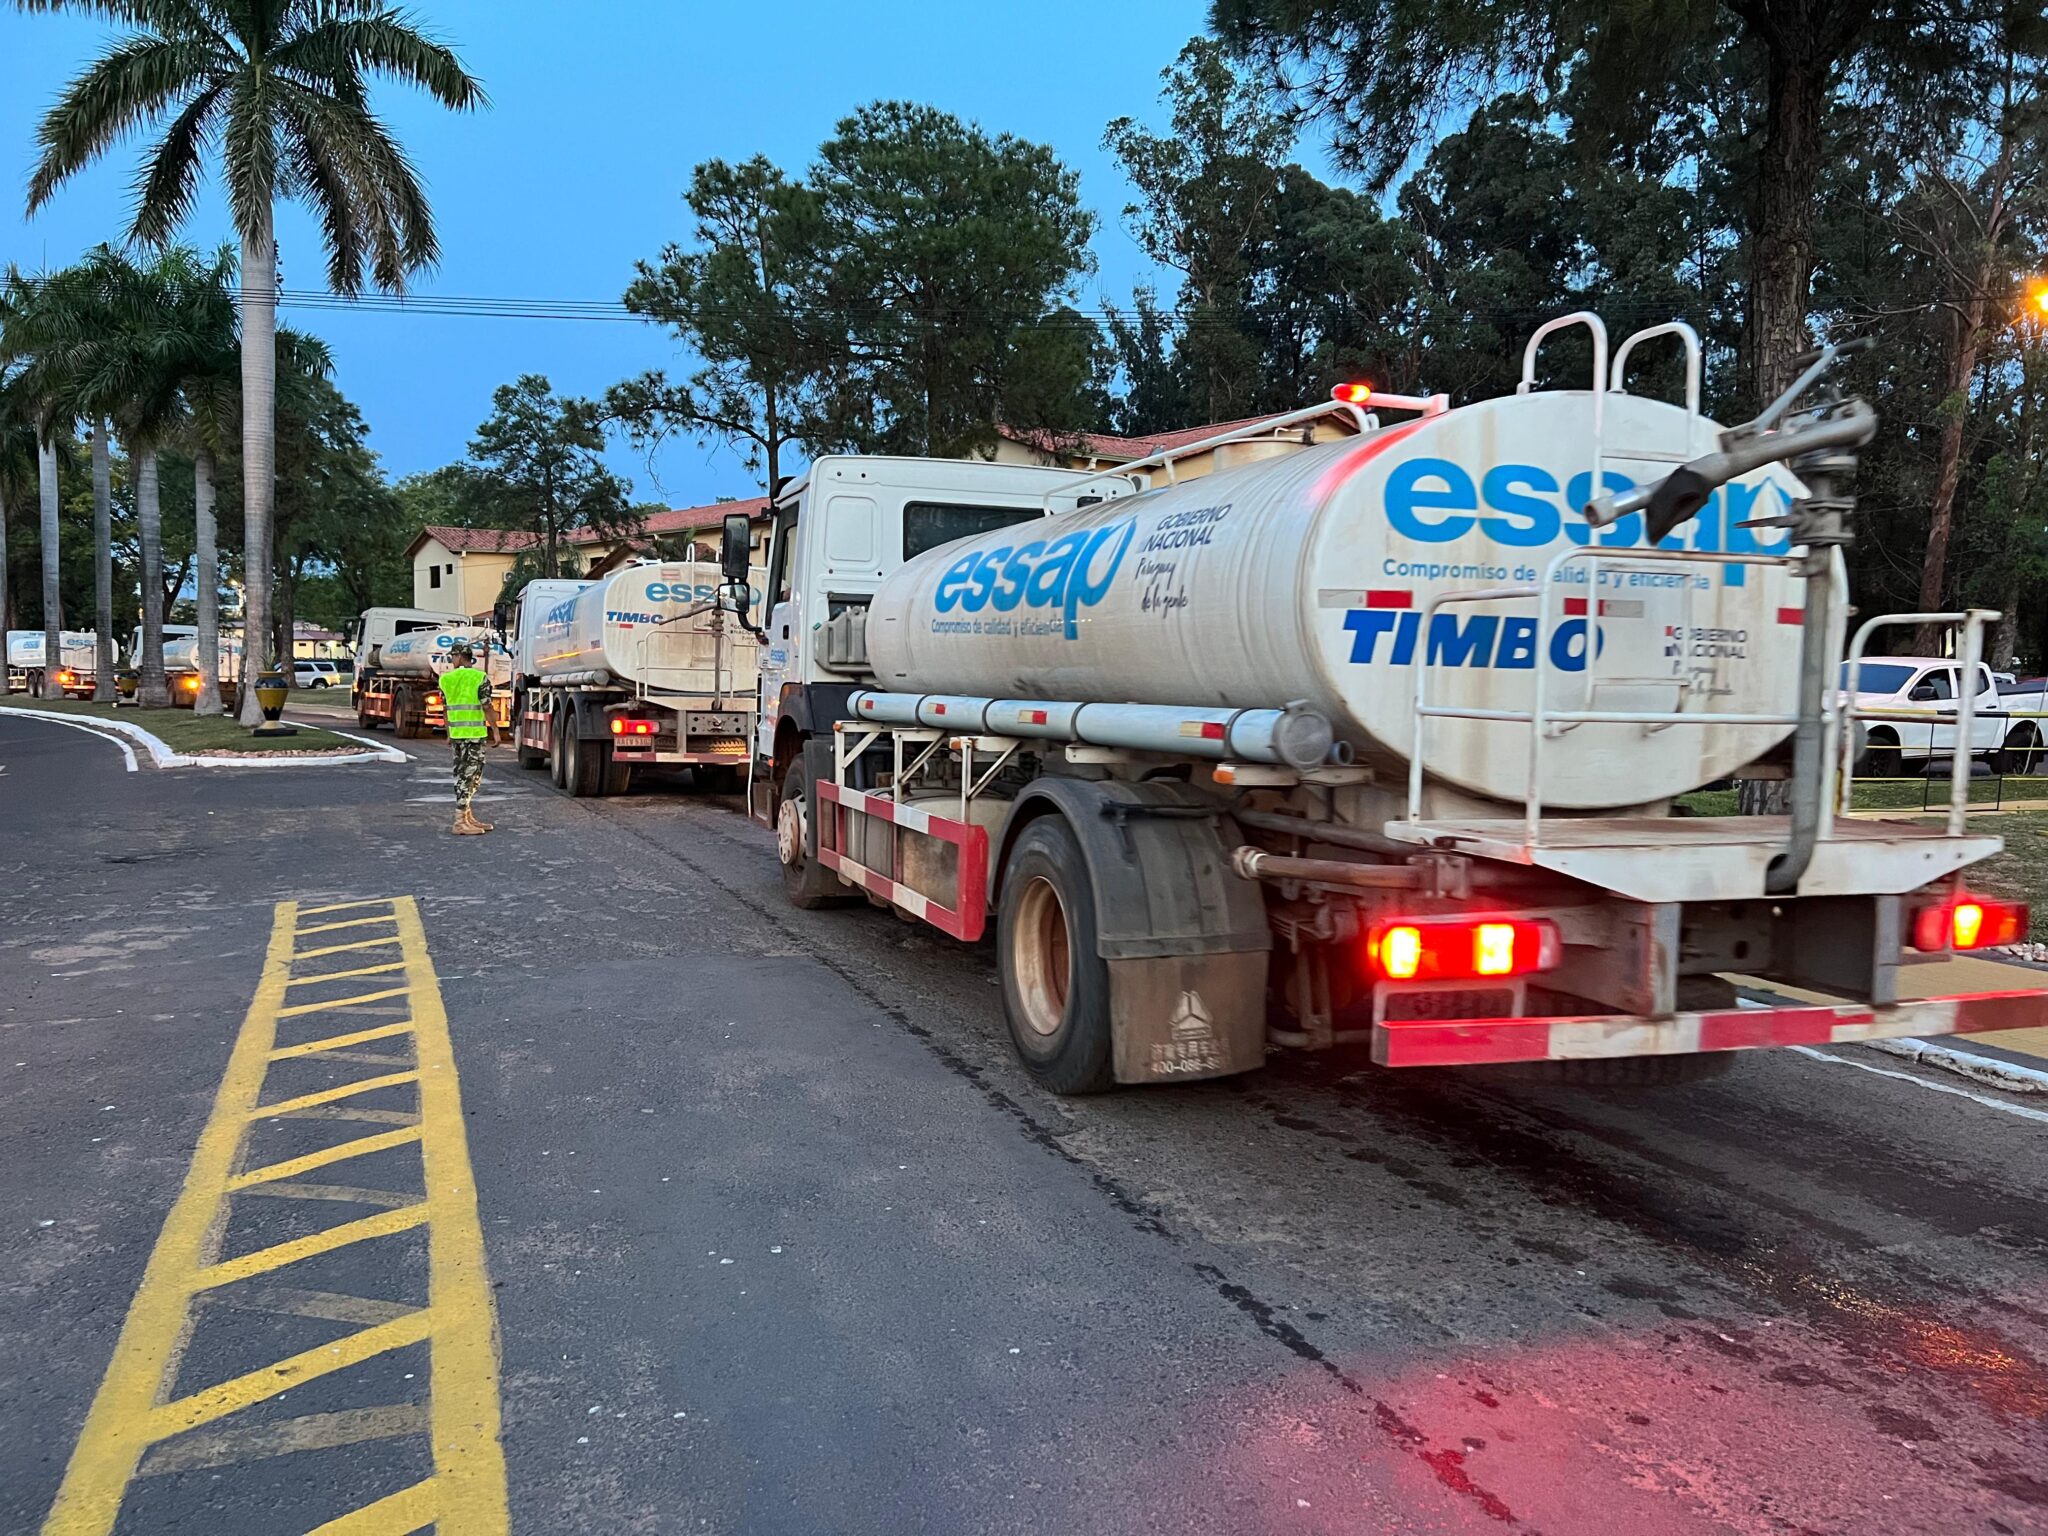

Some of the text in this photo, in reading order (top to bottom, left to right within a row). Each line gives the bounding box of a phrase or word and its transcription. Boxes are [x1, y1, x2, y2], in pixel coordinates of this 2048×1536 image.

[1157, 504, 1232, 531] GOBIERNO
[1143, 525, 1215, 553] NACIONAL
[934, 515, 1138, 641] essap
[1383, 559, 1507, 581] Compromiso
[1513, 564, 1536, 581] de
[645, 582, 762, 606] ess
[931, 618, 971, 636] Compromiso
[973, 618, 982, 634] de
[1673, 626, 1748, 643] GBIERNO
[1342, 609, 1605, 673] TIMBO
[1672, 643, 1746, 659] NCIONAL
